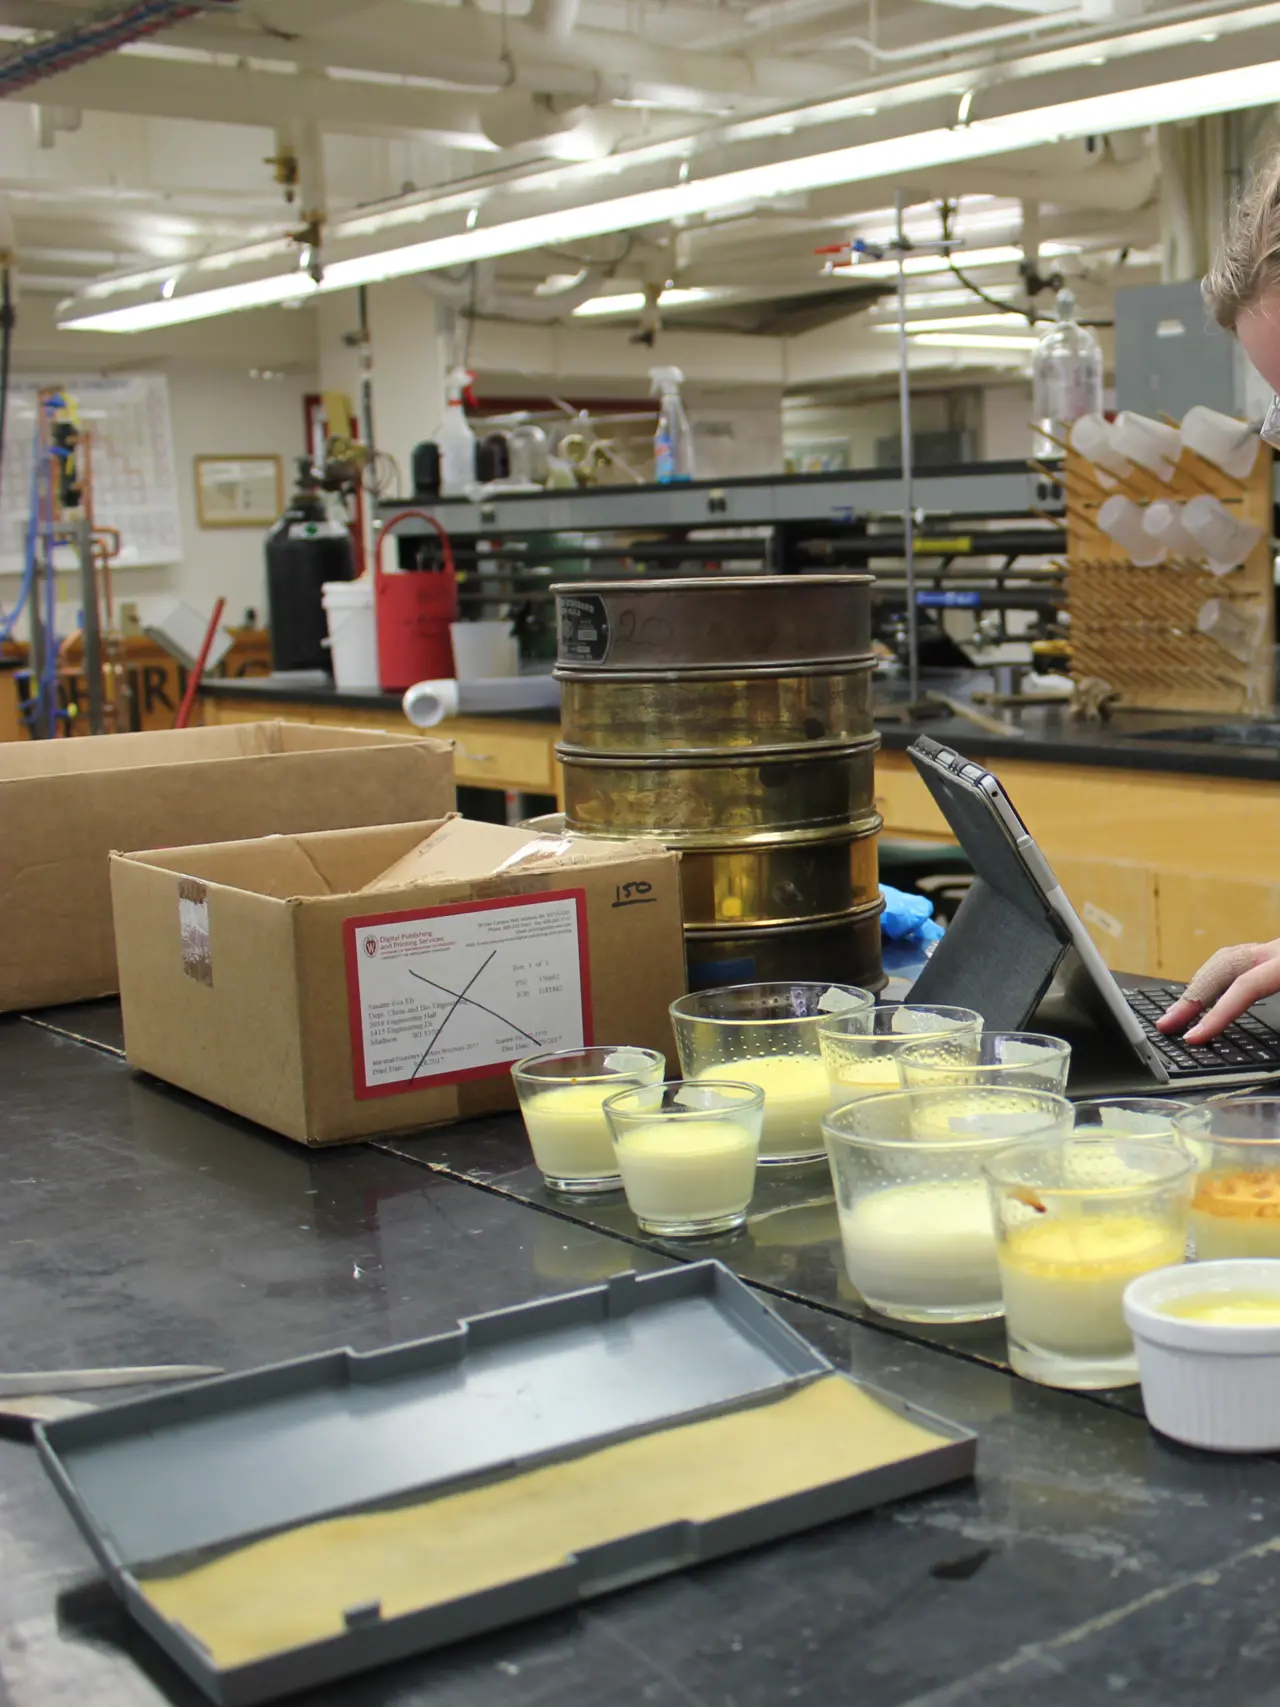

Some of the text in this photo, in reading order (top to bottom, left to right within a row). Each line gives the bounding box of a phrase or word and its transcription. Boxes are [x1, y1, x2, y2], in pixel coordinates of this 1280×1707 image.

[616, 881, 652, 901] 150
[379, 929, 432, 944] Digital Publishing
[394, 938, 418, 948] Printing
[419, 934, 444, 944] Services
